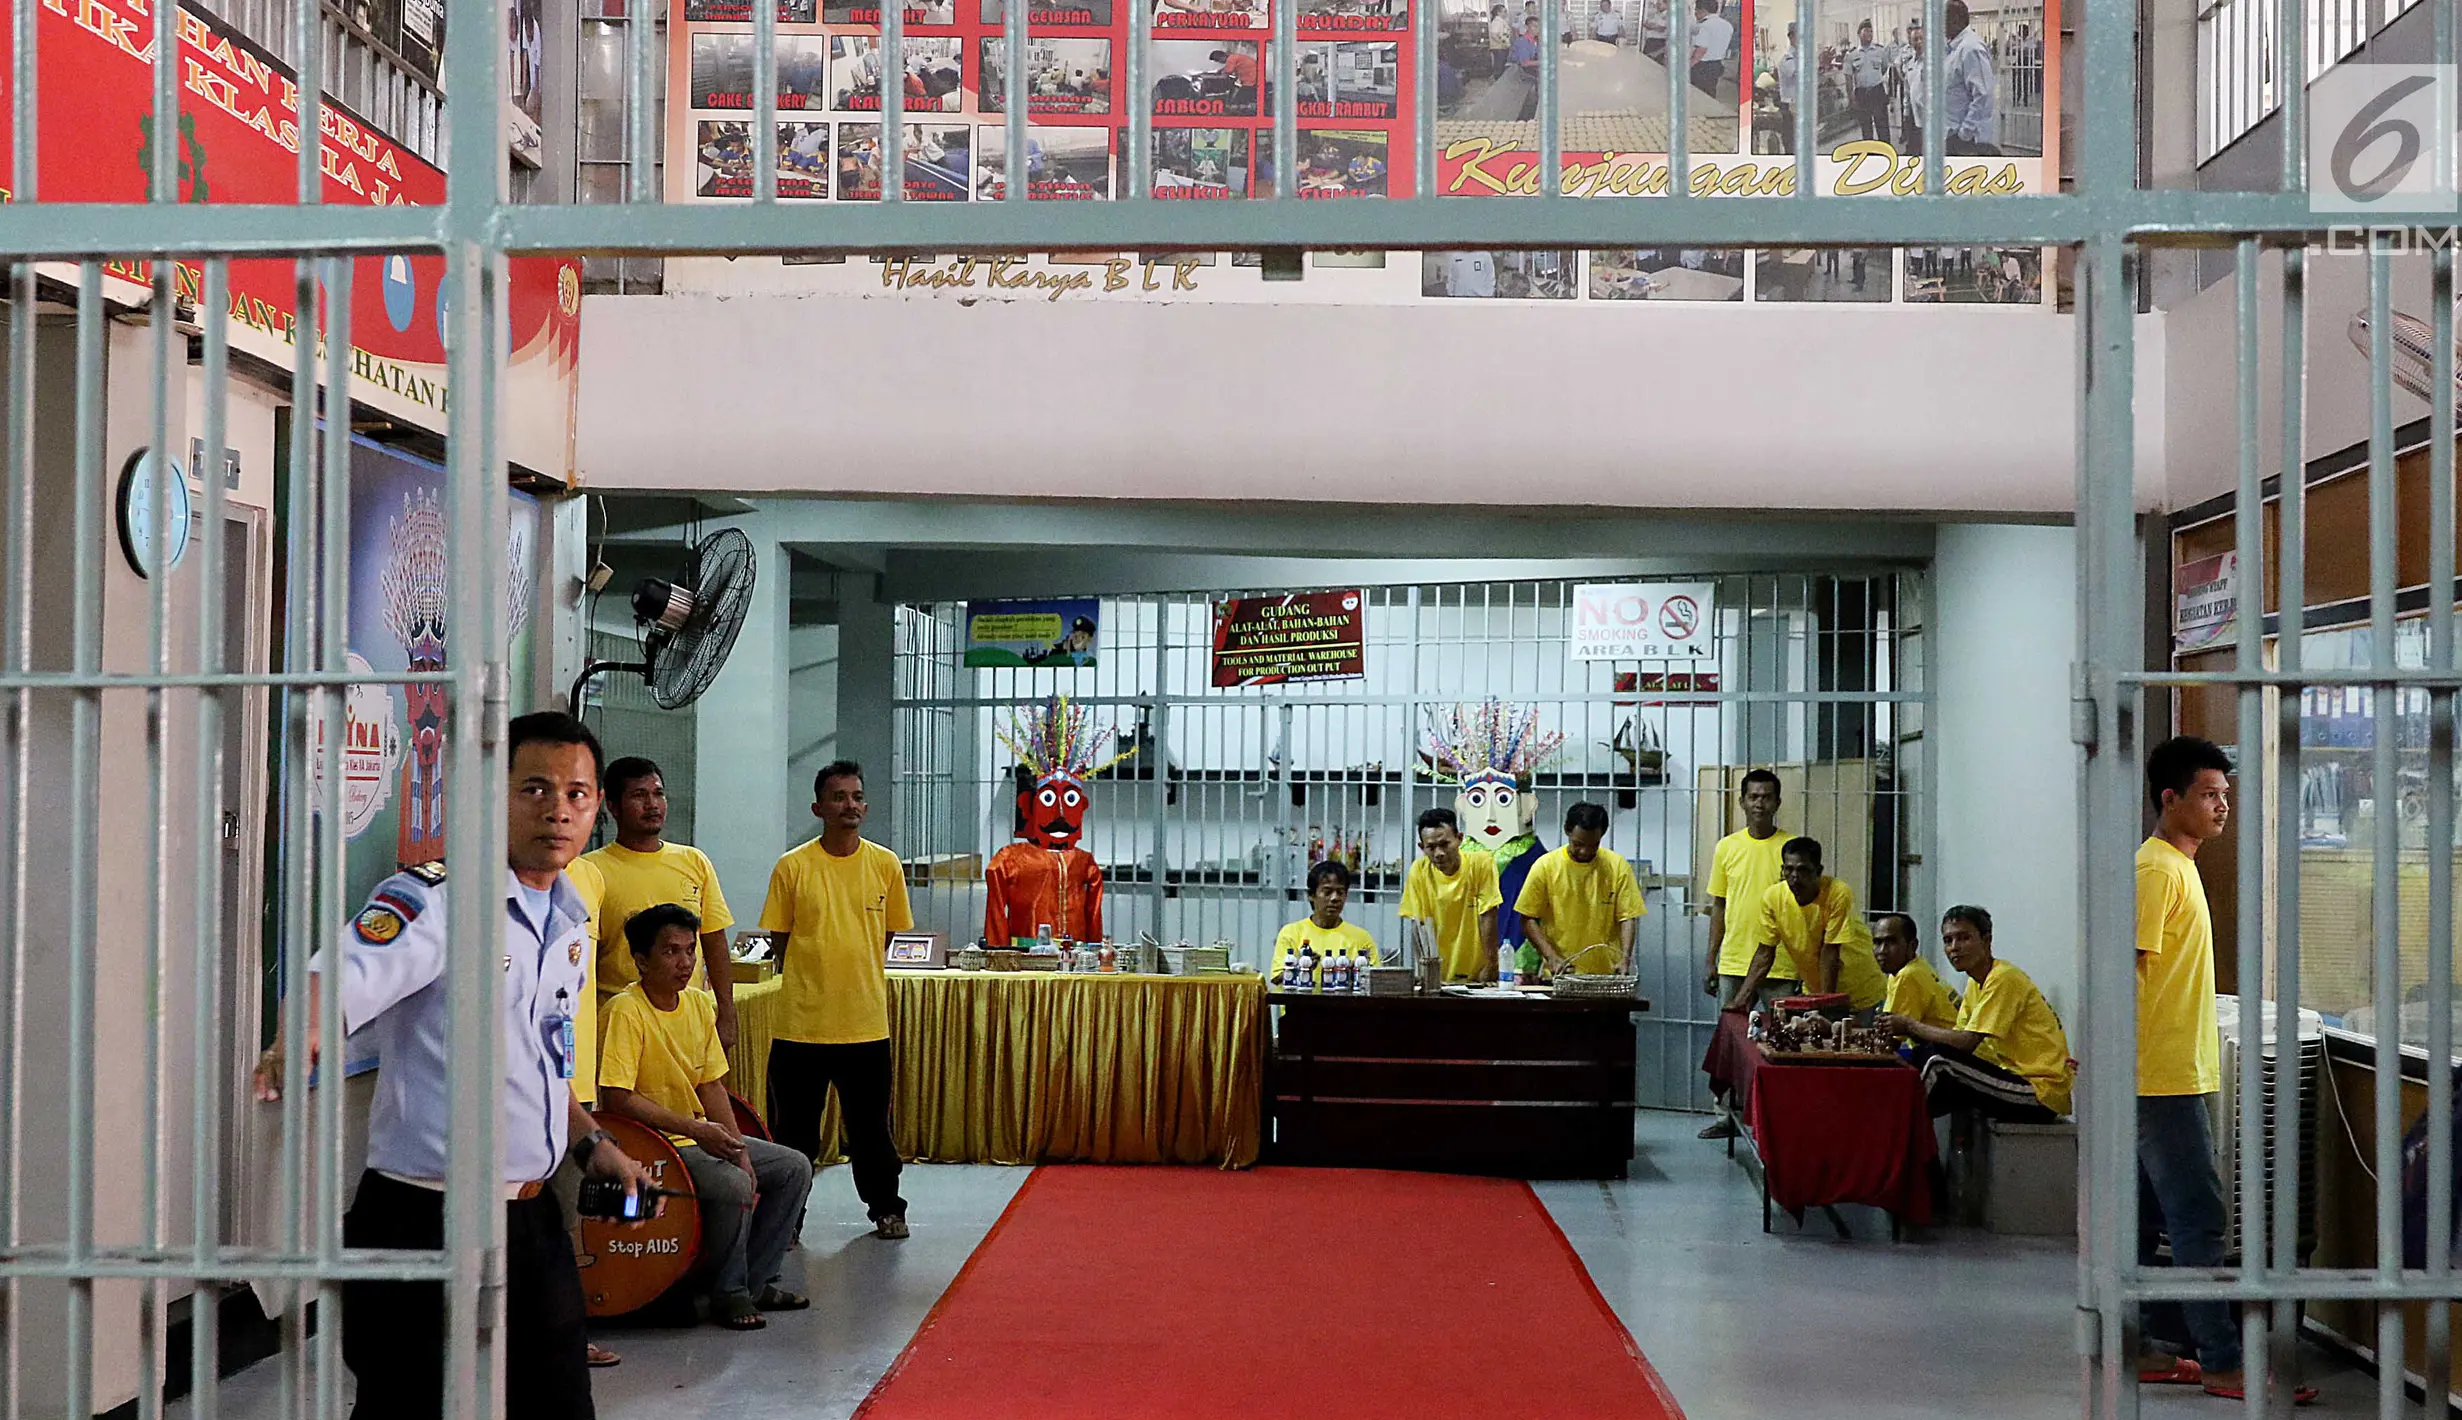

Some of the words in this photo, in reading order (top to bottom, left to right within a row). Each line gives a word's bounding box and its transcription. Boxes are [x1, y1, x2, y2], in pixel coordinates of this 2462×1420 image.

[1157, 12, 1251, 28] PERKAYUAN
[707, 93, 742, 108] CAKE
[774, 93, 808, 109] KERY
[848, 96, 942, 111] KALRAFI
[1155, 98, 1224, 114] SABLON
[1336, 102, 1388, 117] RAMBUT
[319, 144, 364, 196] IA
[882, 255, 976, 290] Hasil
[986, 255, 1093, 301] Karya
[1103, 257, 1131, 293] B
[1141, 258, 1160, 291] L
[1172, 258, 1200, 291] K
[1261, 603, 1310, 618] GUDANG
[1578, 595, 1649, 626] NO
[1229, 620, 1281, 635] ALAT-ALAT,
[1282, 614, 1350, 630] BAHAN-BAHAN
[1240, 634, 1260, 646] DAN
[1261, 631, 1290, 645] HASIL
[1291, 629, 1338, 643] PRODUKSI
[1578, 628, 1648, 641] SMOKING
[1222, 656, 1247, 666] TOOLS
[1249, 653, 1265, 664] AND
[1266, 651, 1306, 663] MATERIAL
[1308, 648, 1358, 661] WAREHOUSE
[1578, 644, 1635, 656] AREA
[1643, 644, 1659, 656] B
[1667, 644, 1681, 656] L
[1688, 643, 1704, 656] K
[1238, 666, 1254, 677] FOR
[1255, 663, 1305, 676] PRODUCTION
[1306, 662, 1323, 673] OUT
[1325, 661, 1341, 672] PUT
[608, 1240, 643, 1258] Stop
[646, 1238, 680, 1254] AIDS
